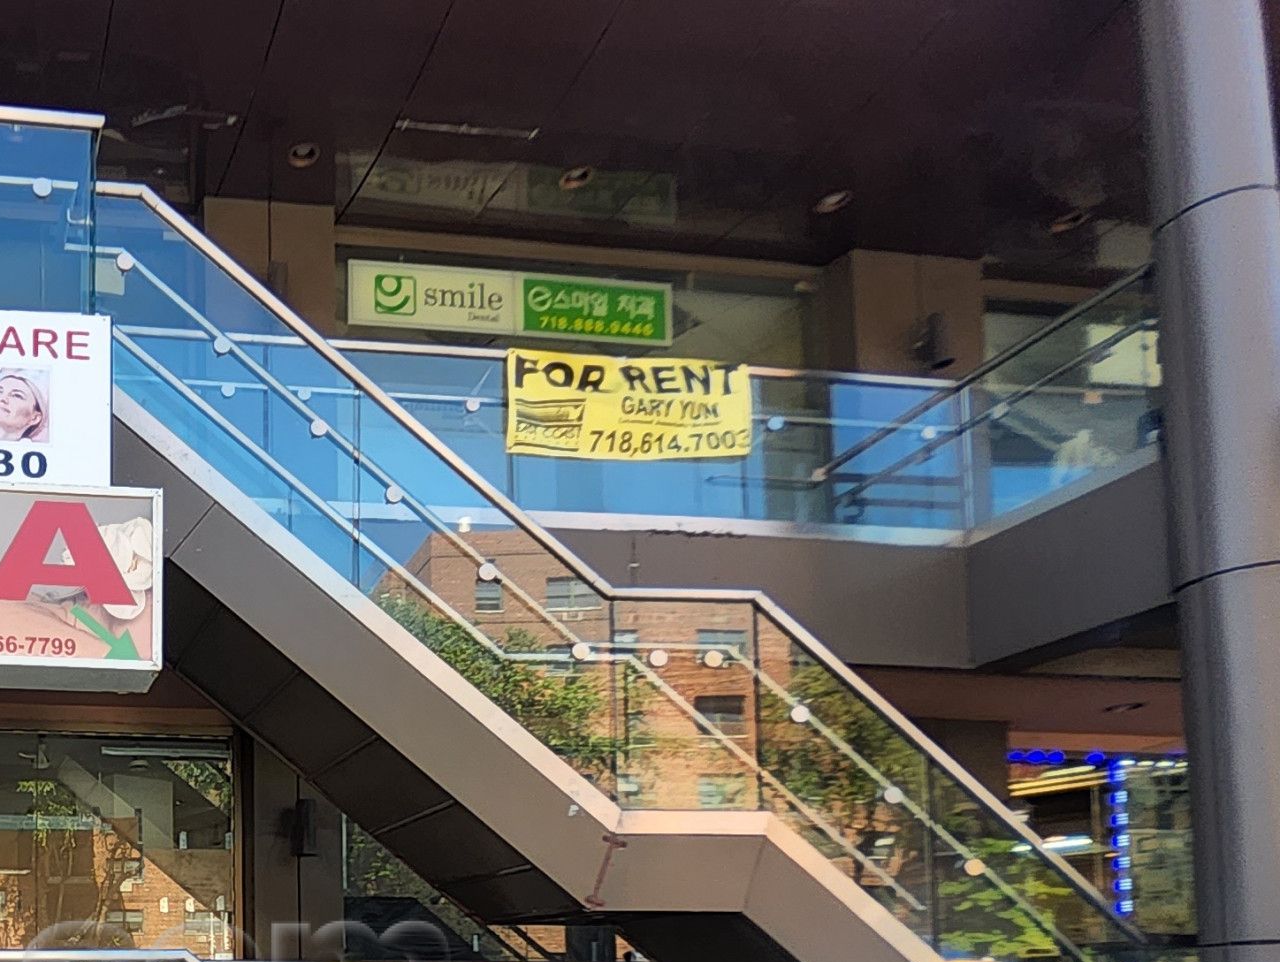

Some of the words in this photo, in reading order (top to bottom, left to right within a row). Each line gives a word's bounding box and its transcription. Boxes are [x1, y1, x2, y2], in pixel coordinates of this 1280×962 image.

[423, 282, 503, 311] smile
[515, 355, 606, 392] FOR
[621, 364, 740, 396] RENT
[621, 395, 674, 418] GARY
